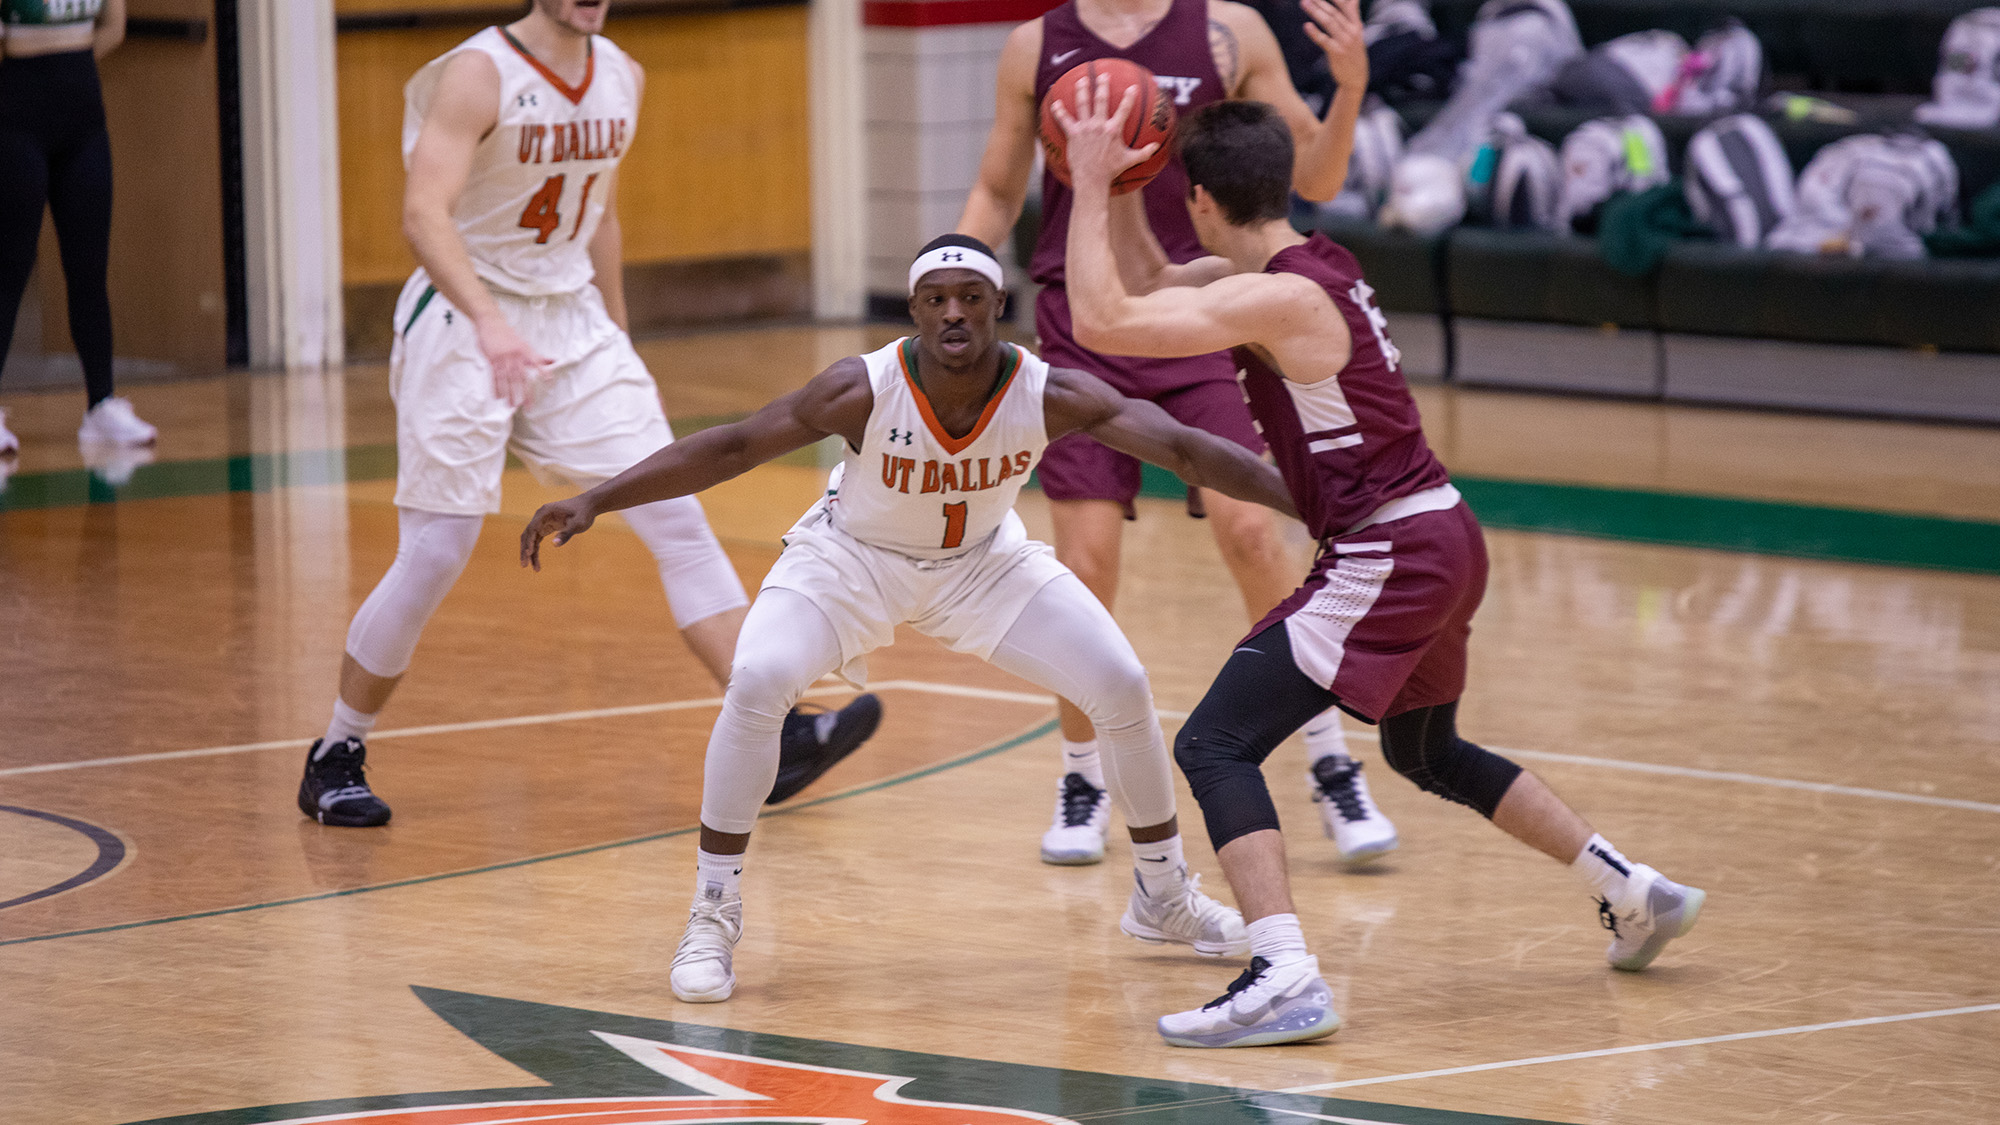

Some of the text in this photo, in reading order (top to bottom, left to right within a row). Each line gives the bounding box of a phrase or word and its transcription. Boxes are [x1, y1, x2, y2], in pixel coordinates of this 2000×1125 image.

[518, 118, 626, 164] UT DALLAS
[518, 172, 599, 244] 41
[882, 450, 1032, 494] UT DALLAS
[941, 500, 968, 549] 1
